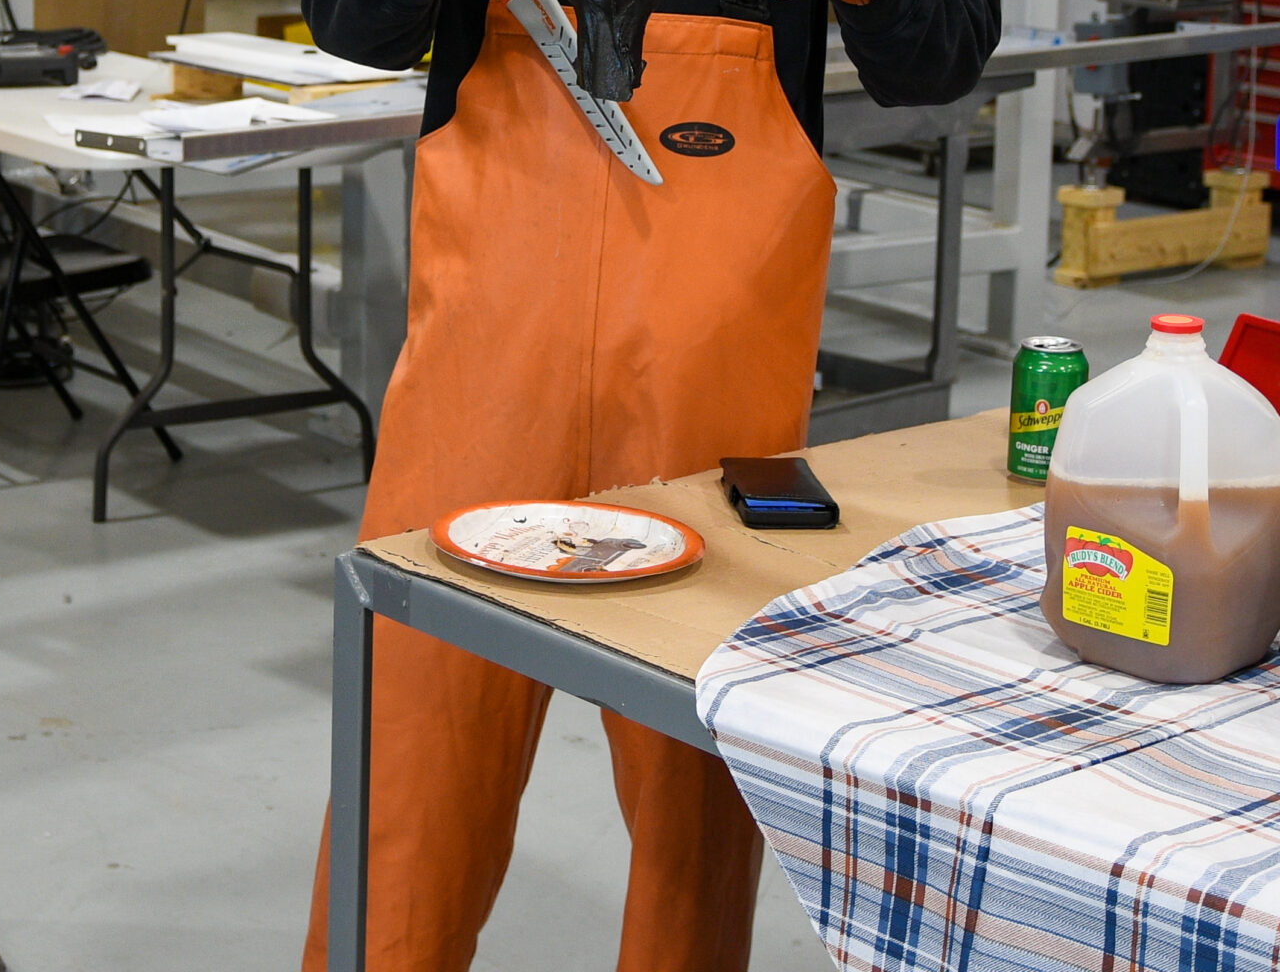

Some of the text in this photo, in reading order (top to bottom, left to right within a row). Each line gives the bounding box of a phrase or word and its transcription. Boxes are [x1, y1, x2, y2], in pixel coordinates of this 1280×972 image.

[1017, 413, 1063, 430] Schwepp
[1015, 441, 1049, 454] GINGER
[1070, 550, 1125, 575] RUDY'S BLEND
[1080, 574, 1111, 585] PREMIUM
[1087, 580, 1116, 591] NATURAL
[1068, 580, 1123, 600] APPLE CIDER
